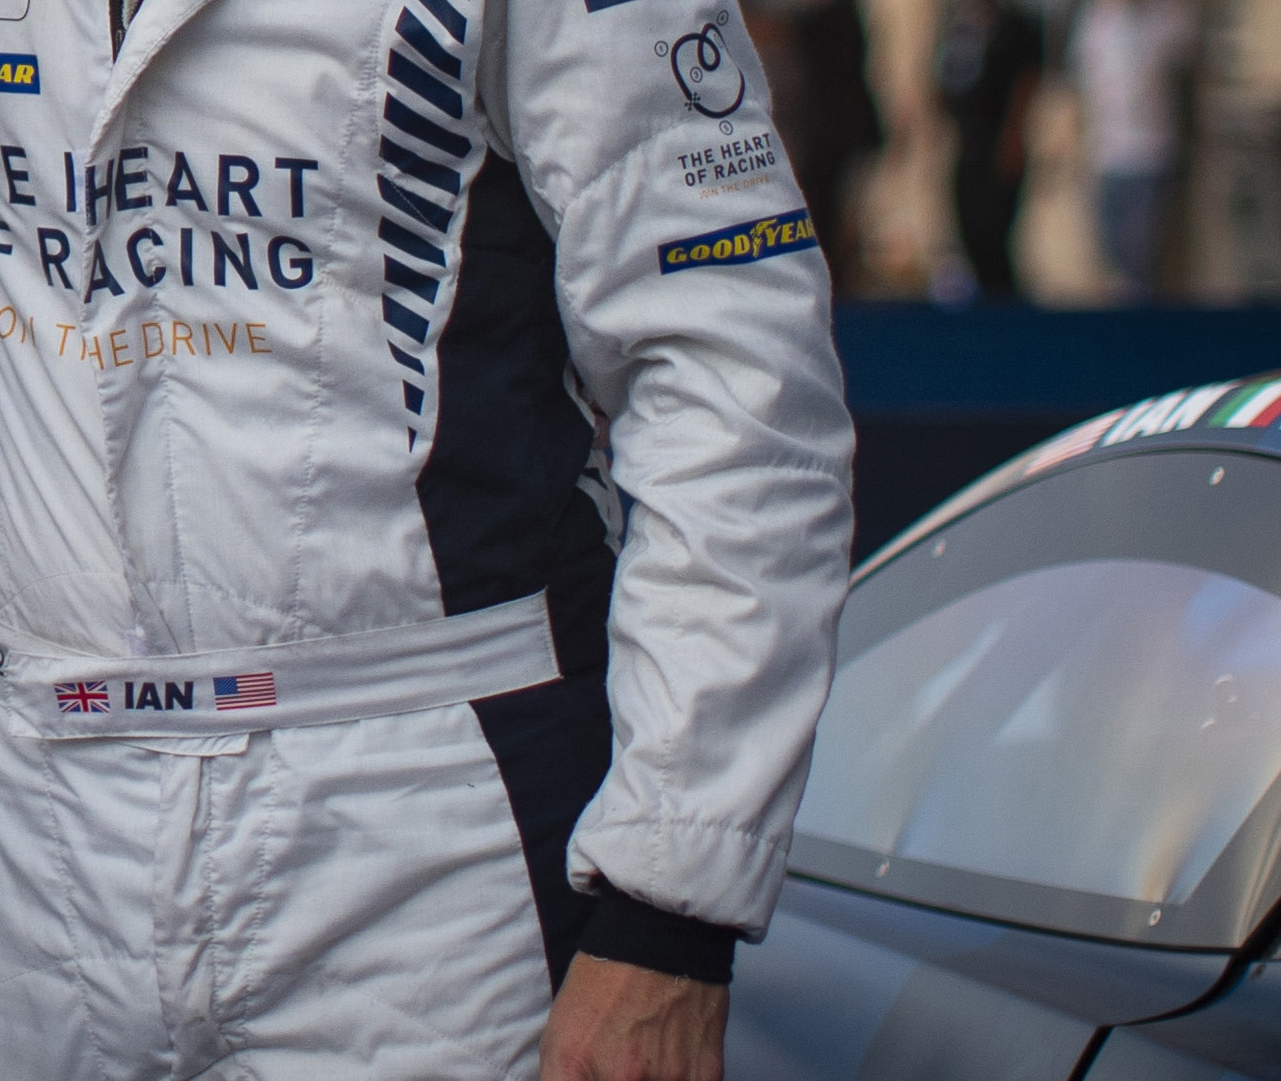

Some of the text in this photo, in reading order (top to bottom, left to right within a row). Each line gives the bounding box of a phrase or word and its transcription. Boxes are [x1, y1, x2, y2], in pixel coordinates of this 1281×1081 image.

[677, 133, 770, 170] THE HEART
[684, 151, 776, 187] OF RACING
[64, 147, 319, 227] HEART
[37, 227, 315, 305] RACING
[56, 324, 134, 371] THE
[141, 321, 273, 359] DRIVE
[124, 681, 195, 710] IAN
